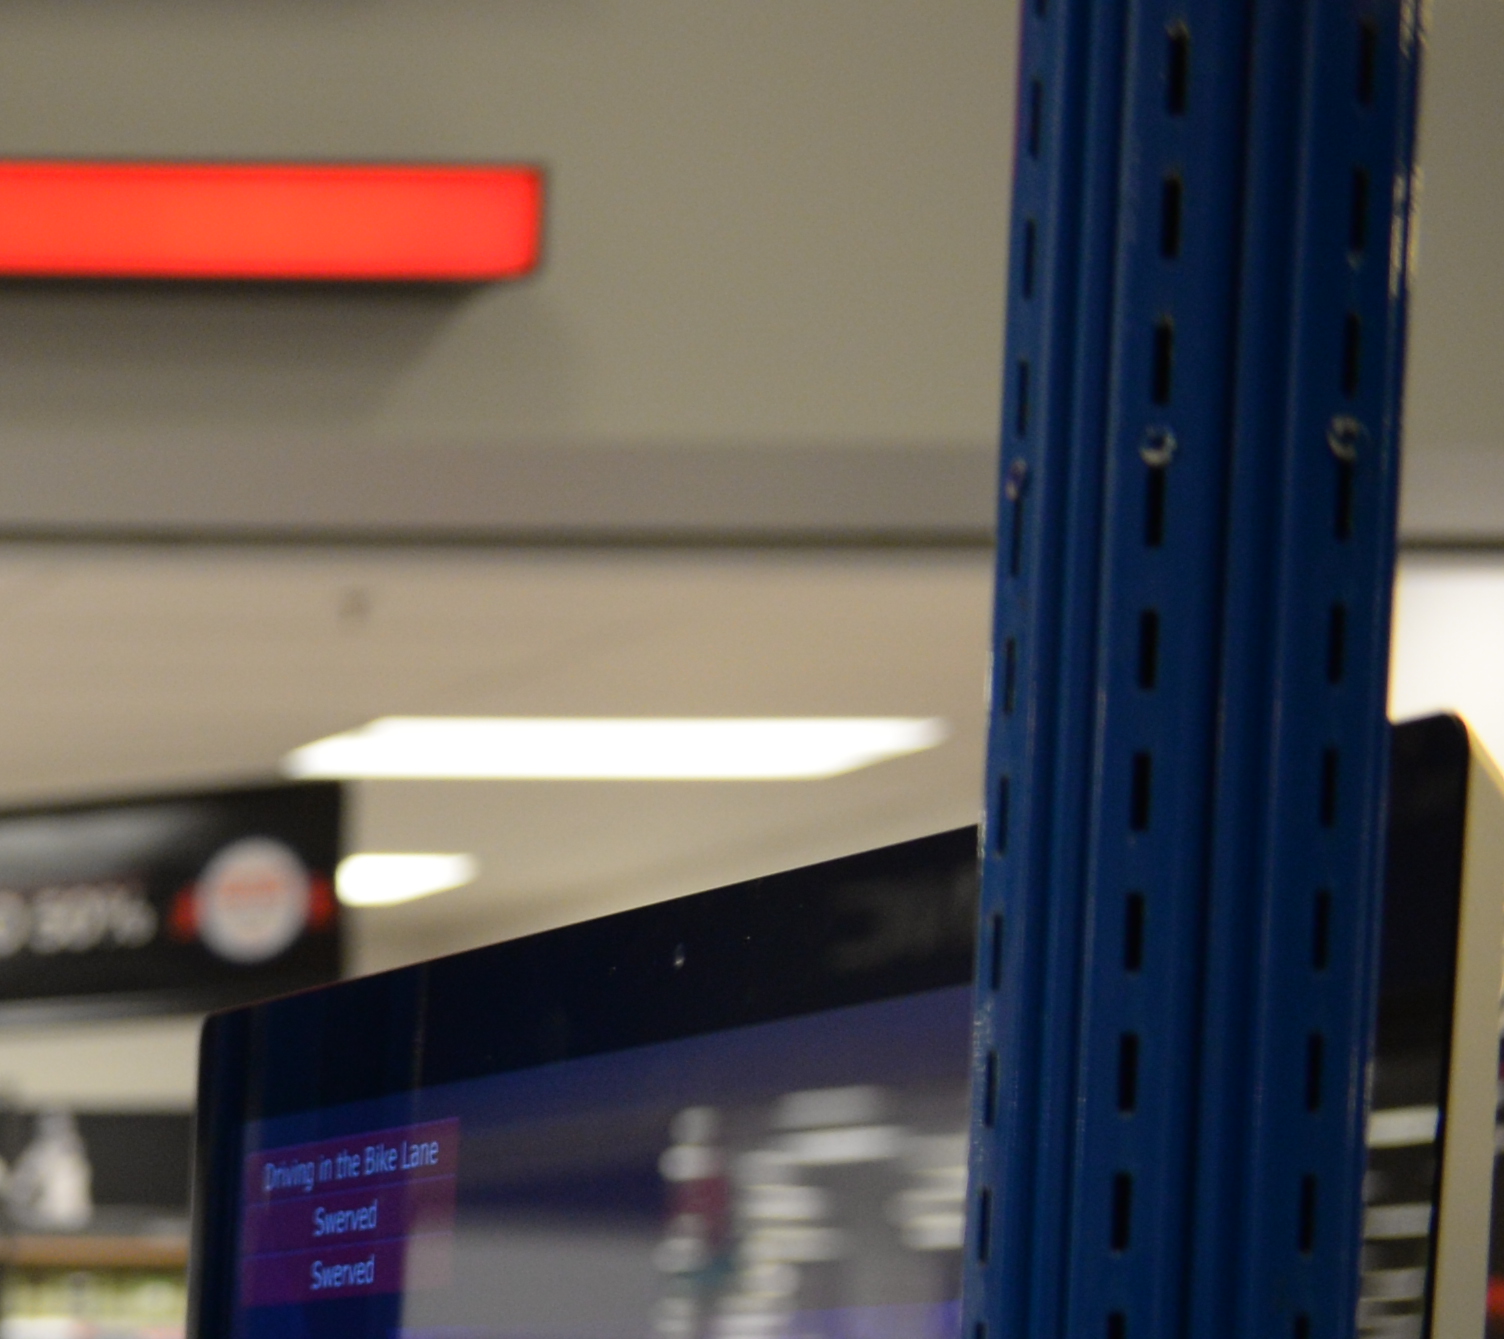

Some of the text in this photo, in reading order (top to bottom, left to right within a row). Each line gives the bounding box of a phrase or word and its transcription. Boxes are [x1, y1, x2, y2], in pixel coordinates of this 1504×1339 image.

[263, 1139, 440, 1192] Driving in the Bike Lane
[312, 1198, 379, 1237] Swerved
[309, 1253, 376, 1291] Swerved
